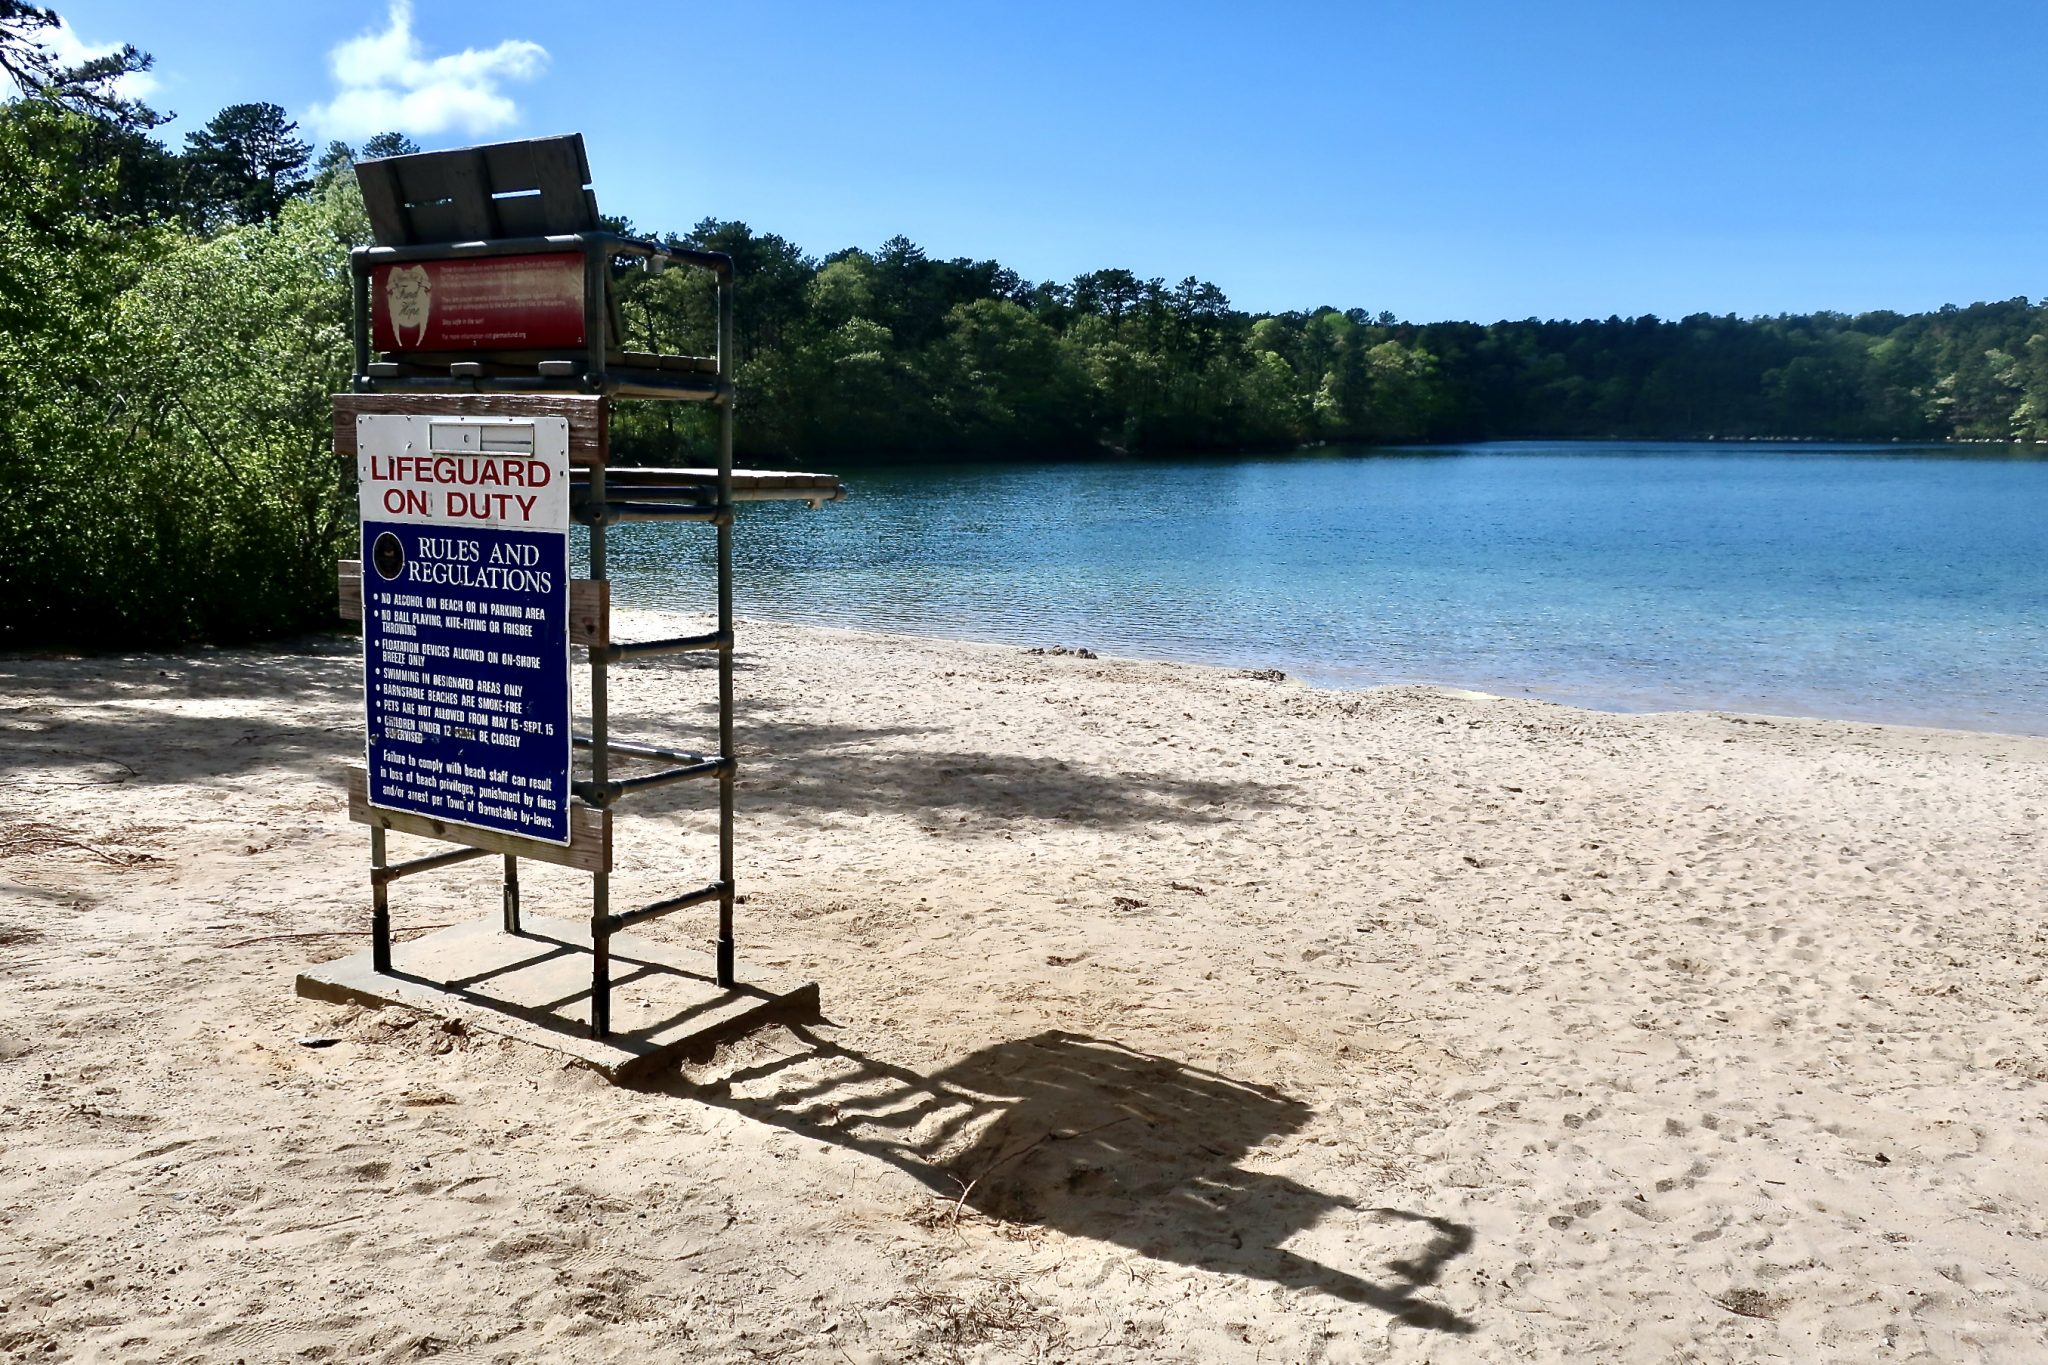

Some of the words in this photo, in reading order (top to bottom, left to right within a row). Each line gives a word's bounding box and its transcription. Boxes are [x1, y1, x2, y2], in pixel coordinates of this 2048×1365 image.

[370, 455, 551, 487] LIFEGUARD
[384, 489, 427, 515] ON
[447, 492, 537, 521] DUTY
[418, 537, 480, 562] RULES
[489, 543, 540, 566] AND
[408, 561, 552, 593] REGULATIONS
[381, 593, 391, 604] NO
[394, 594, 423, 608] ALCOHOL
[427, 597, 436, 609] ON
[440, 599, 463, 612] BEACH
[466, 601, 476, 613] OR
[480, 603, 487, 614] IN
[491, 604, 522, 618] PARKING
[525, 608, 545, 620] AREA
[381, 610, 391, 621] NO
[394, 611, 410, 623] BALL
[413, 613, 442, 627] PLAYING,
[446, 617, 486, 632] KITE-FLYING
[489, 621, 499, 633] OR
[504, 622, 532, 637] FRISBEE
[383, 622, 416, 636] THROWING
[382, 639, 419, 653] FLOATATION
[422, 643, 449, 657] DEVICES
[453, 647, 484, 662] ALLOWED
[488, 652, 498, 664] ON
[502, 653, 540, 669] ON-SHORE
[383, 652, 405, 664] BREEZE
[409, 655, 425, 667] ONLY
[383, 668, 419, 683] SWIMMING
[423, 673, 430, 684] IN
[433, 675, 473, 690] DESIGNATED
[477, 680, 501, 693] AREAS
[504, 684, 522, 697] ONLY
[384, 683, 424, 700] BARNSTABLE
[428, 689, 458, 704] BEACHES
[461, 695, 475, 707] ARE
[478, 698, 522, 714] SMOKE-FREE
[384, 700, 399, 712] PETS
[402, 703, 415, 715] ARE
[418, 706, 431, 717] NOT
[434, 708, 465, 722] ALLOWED
[469, 713, 488, 726] FROM
[492, 716, 507, 729] MAY
[546, 724, 554, 735] 15
[385, 716, 415, 730] CHILDREN
[418, 722, 440, 735] UNDER
[444, 725, 451, 736] 12
[479, 730, 489, 743] BE
[491, 732, 520, 747] CLOSELY
[385, 728, 423, 744] SUPERVISED
[384, 749, 405, 765] Failure
[408, 754, 416, 767] to
[418, 758, 443, 774] comply
[446, 762, 461, 775] with
[465, 764, 486, 779] beach
[489, 770, 508, 783] staff
[512, 774, 526, 787] can
[529, 777, 551, 791] result
[380, 766, 386, 778] in
[389, 768, 403, 781] loss
[406, 770, 412, 783] of
[416, 772, 436, 788] beach
[440, 777, 476, 796] privileges,
[479, 786, 520, 803] punishment
[524, 794, 533, 807] by
[537, 797, 556, 810] fines
[383, 785, 404, 797] and/or
[408, 790, 428, 803] arrest
[432, 795, 443, 806] per
[446, 795, 464, 811] Town
[467, 800, 474, 812] of
[478, 803, 518, 821] Barnstable
[521, 809, 554, 829] by-laws.
